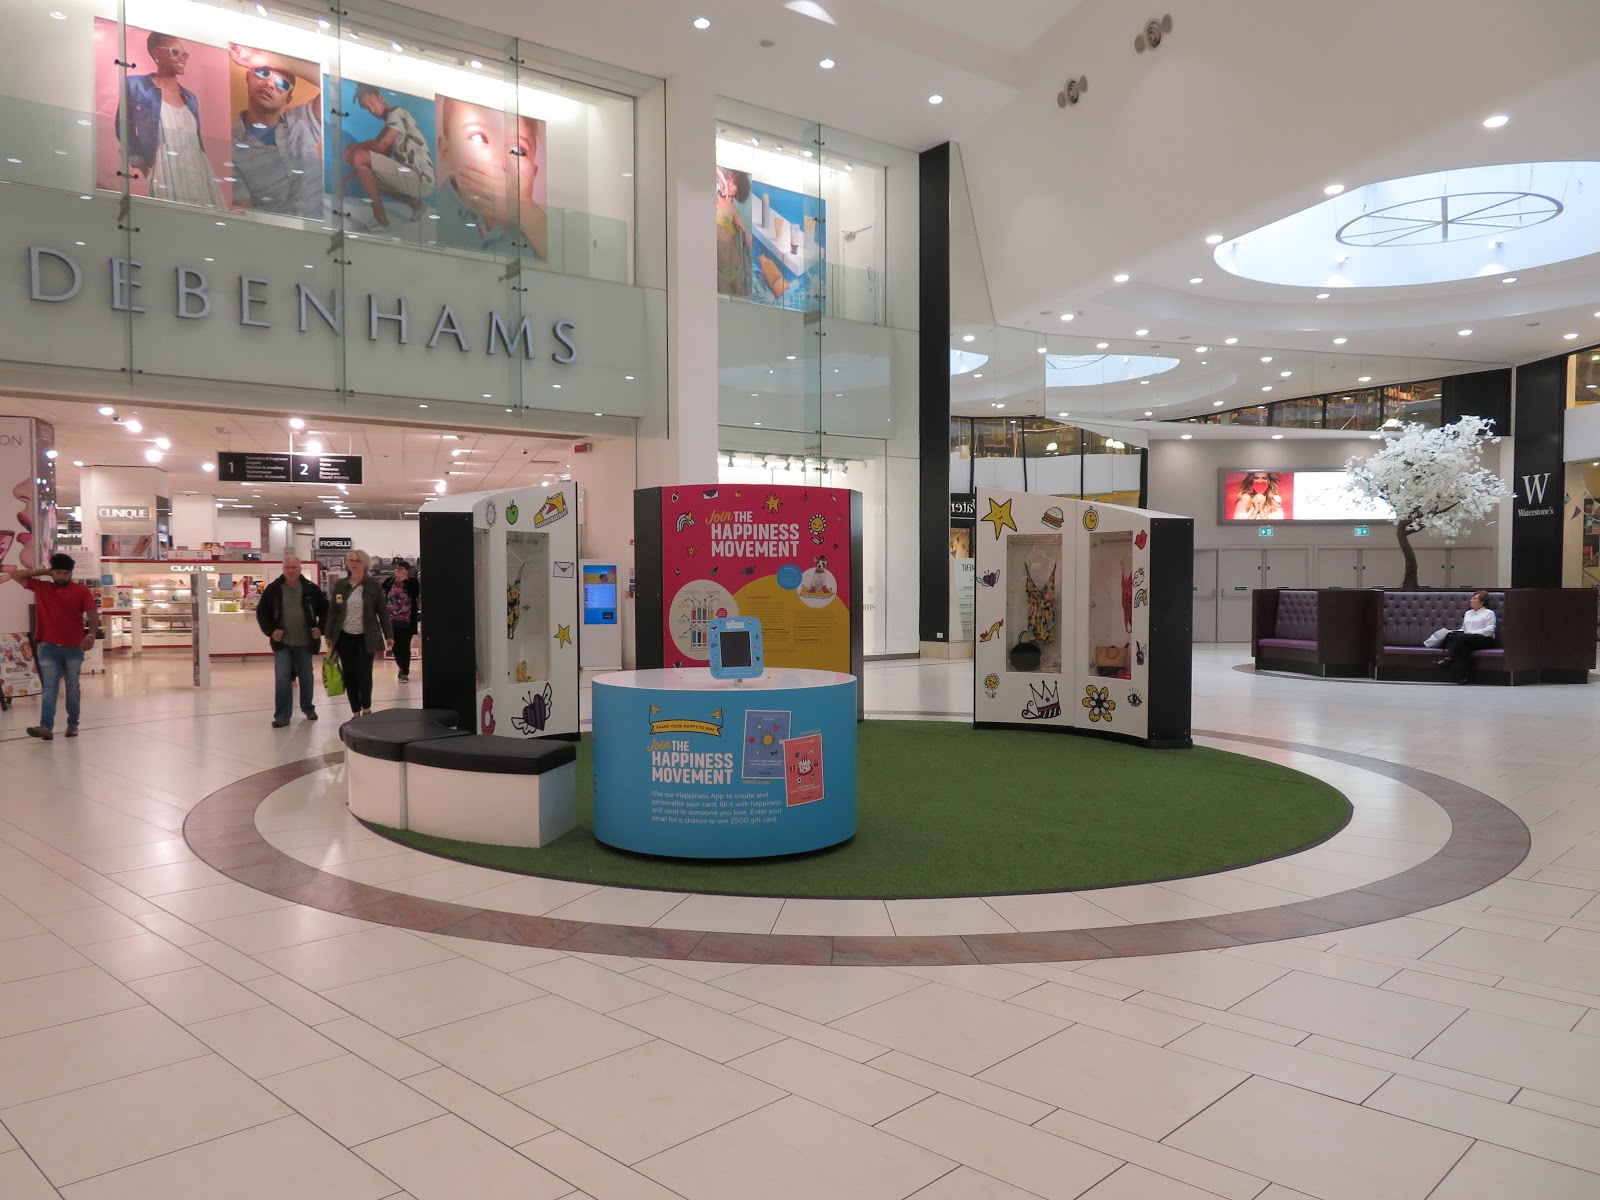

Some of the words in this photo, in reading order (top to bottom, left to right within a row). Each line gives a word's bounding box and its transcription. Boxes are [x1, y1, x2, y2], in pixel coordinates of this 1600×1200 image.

[27, 246, 578, 364] DEBENHAMS
[228, 462, 234, 474] 1
[300, 463, 309, 475] 2
[1522, 473, 1551, 505] W
[99, 508, 147, 520] CLINIQUE
[705, 510, 733, 524] Join
[733, 511, 753, 522] THE
[1518, 506, 1554, 517] Waterstone's
[711, 523, 800, 540] HAPPINESS
[711, 541, 800, 557] MOVEMENT
[647, 738, 671, 752] Join
[672, 740, 690, 752] THE
[652, 751, 734, 769] HAPPINESS
[652, 767, 734, 785] MOVEMENT
[676, 792, 709, 800] Happiness
[711, 793, 725, 801] App
[750, 799, 782, 807] happiness
